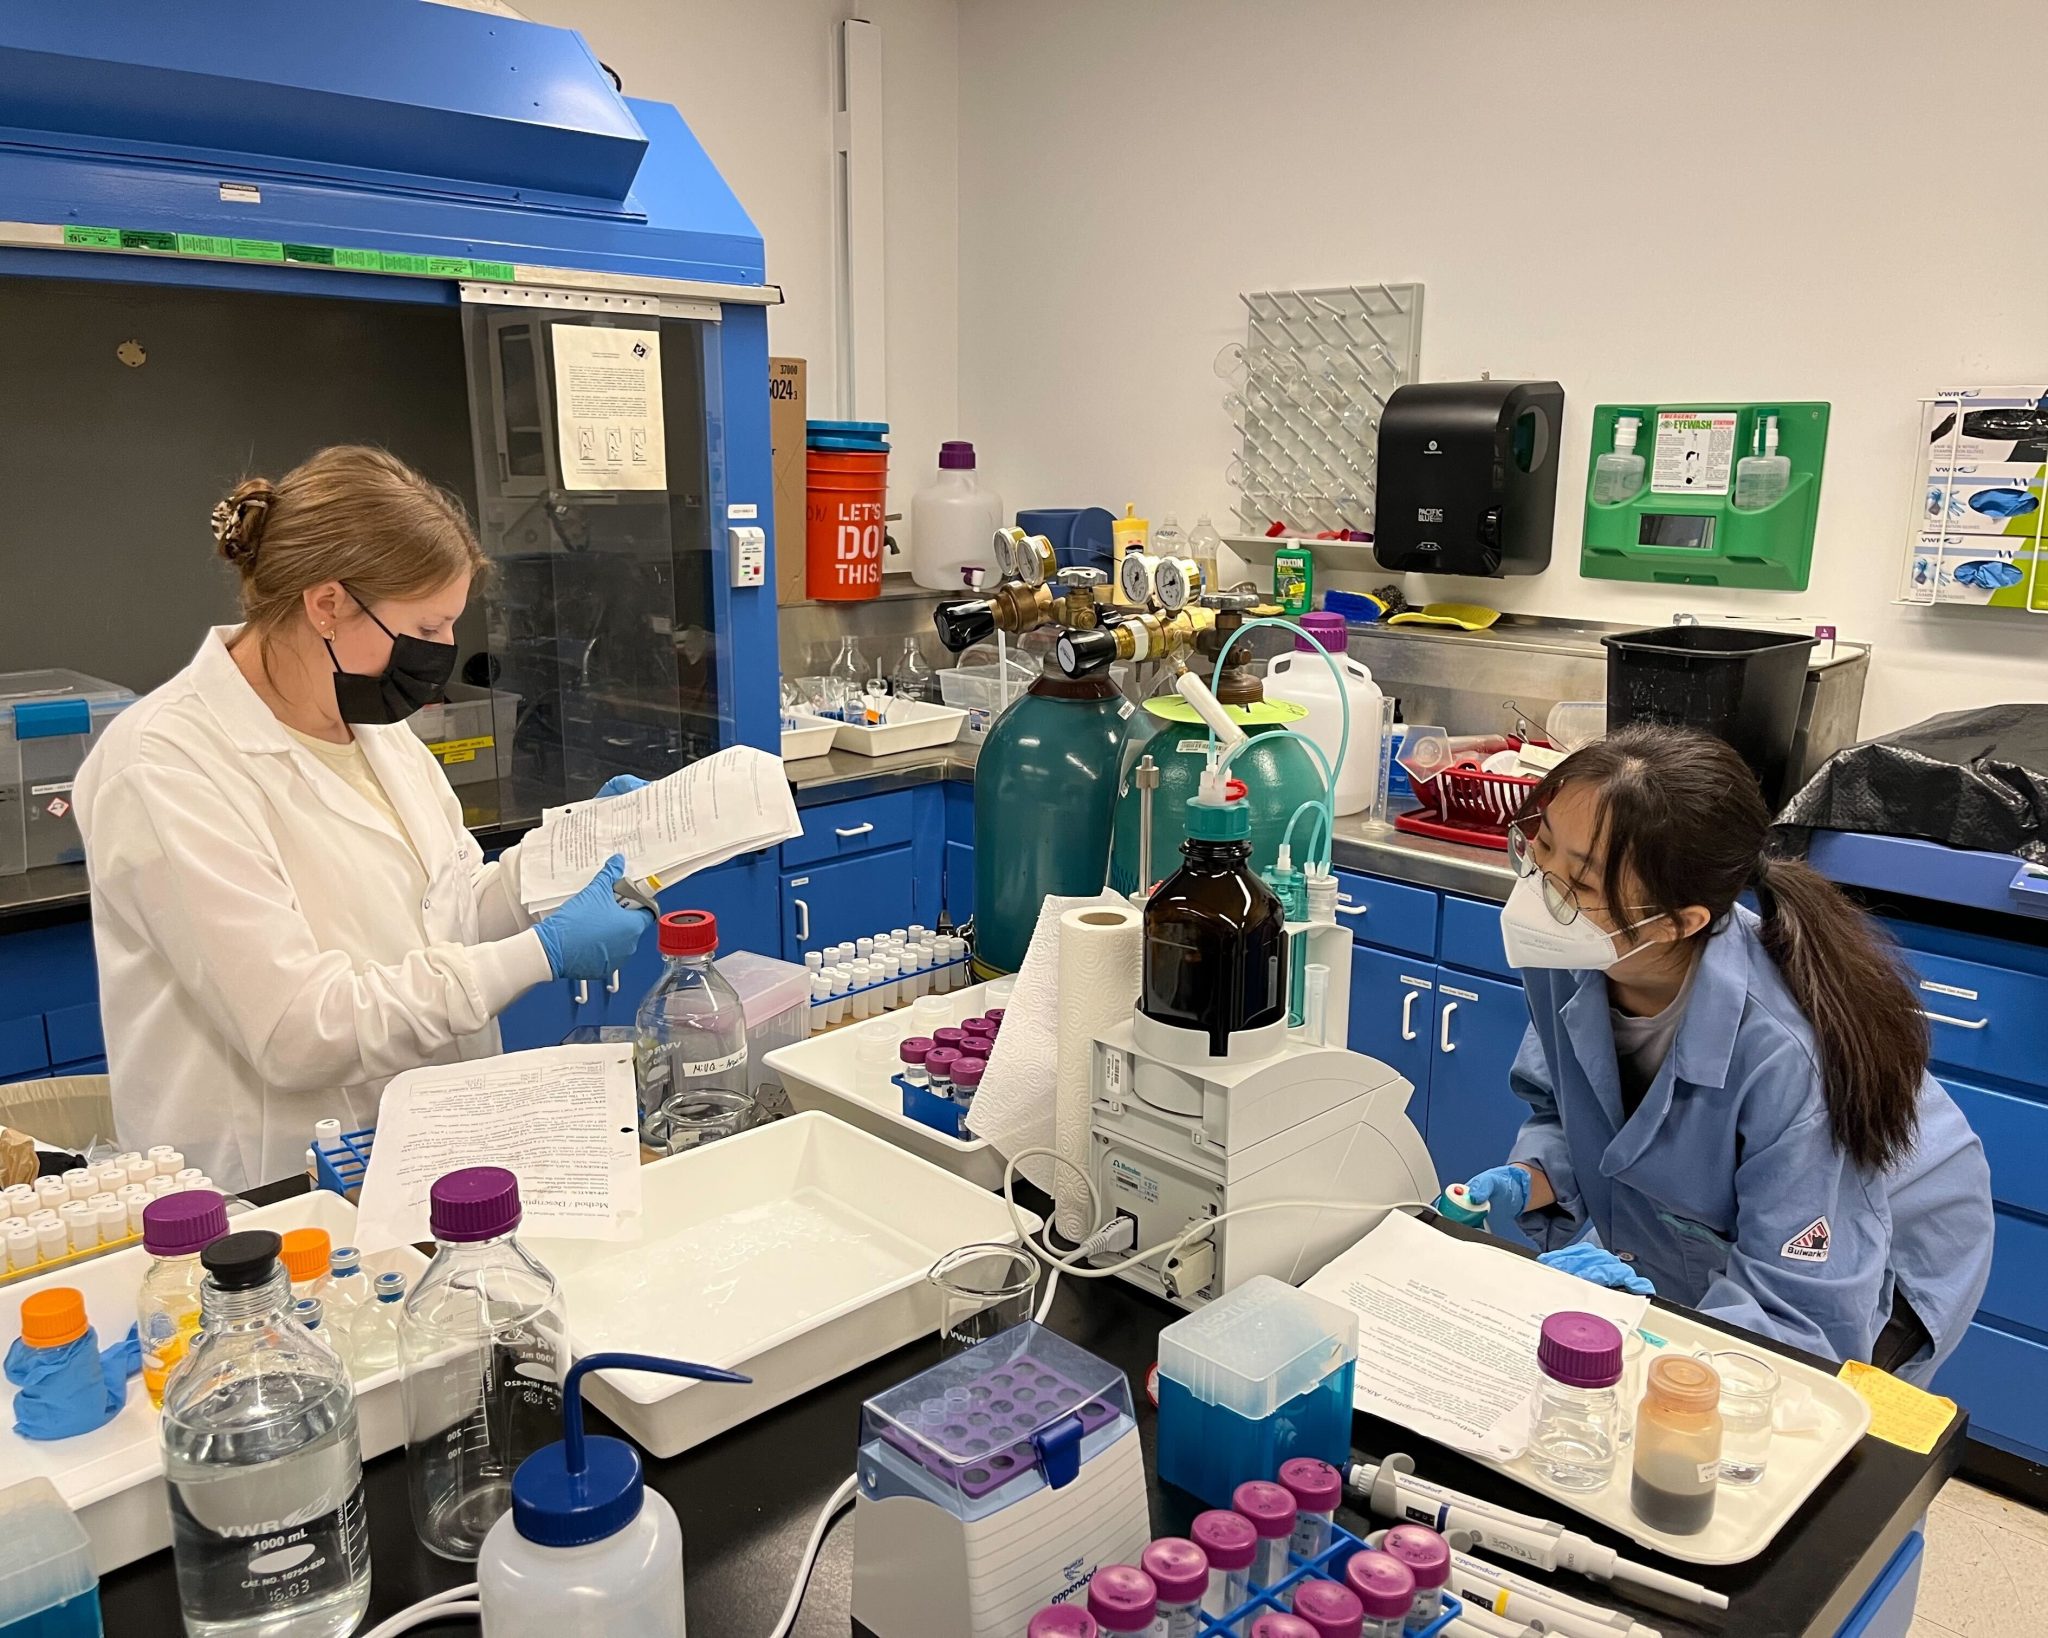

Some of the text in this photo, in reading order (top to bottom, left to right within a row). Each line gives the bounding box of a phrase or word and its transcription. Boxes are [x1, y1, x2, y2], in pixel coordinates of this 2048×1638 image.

[1673, 420, 1713, 430] EYEWASH
[838, 503, 881, 521] LET'S
[837, 525, 879, 560] DO
[835, 564, 880, 585] THIS.
[521, 1199, 566, 1208] Descriptio
[574, 1201, 609, 1209] Method
[1787, 1246, 1822, 1258] Bulwark
[949, 1329, 976, 1345] VWR
[1399, 1476, 1442, 1495] eppendorf
[217, 1520, 280, 1538] VWR
[252, 1528, 309, 1551] 1000 mL
[240, 1557, 326, 1589] CAT. NO. 10754-820
[1455, 1556, 1502, 1578] eppendorf
[1051, 1564, 1098, 1605] eppendorf
